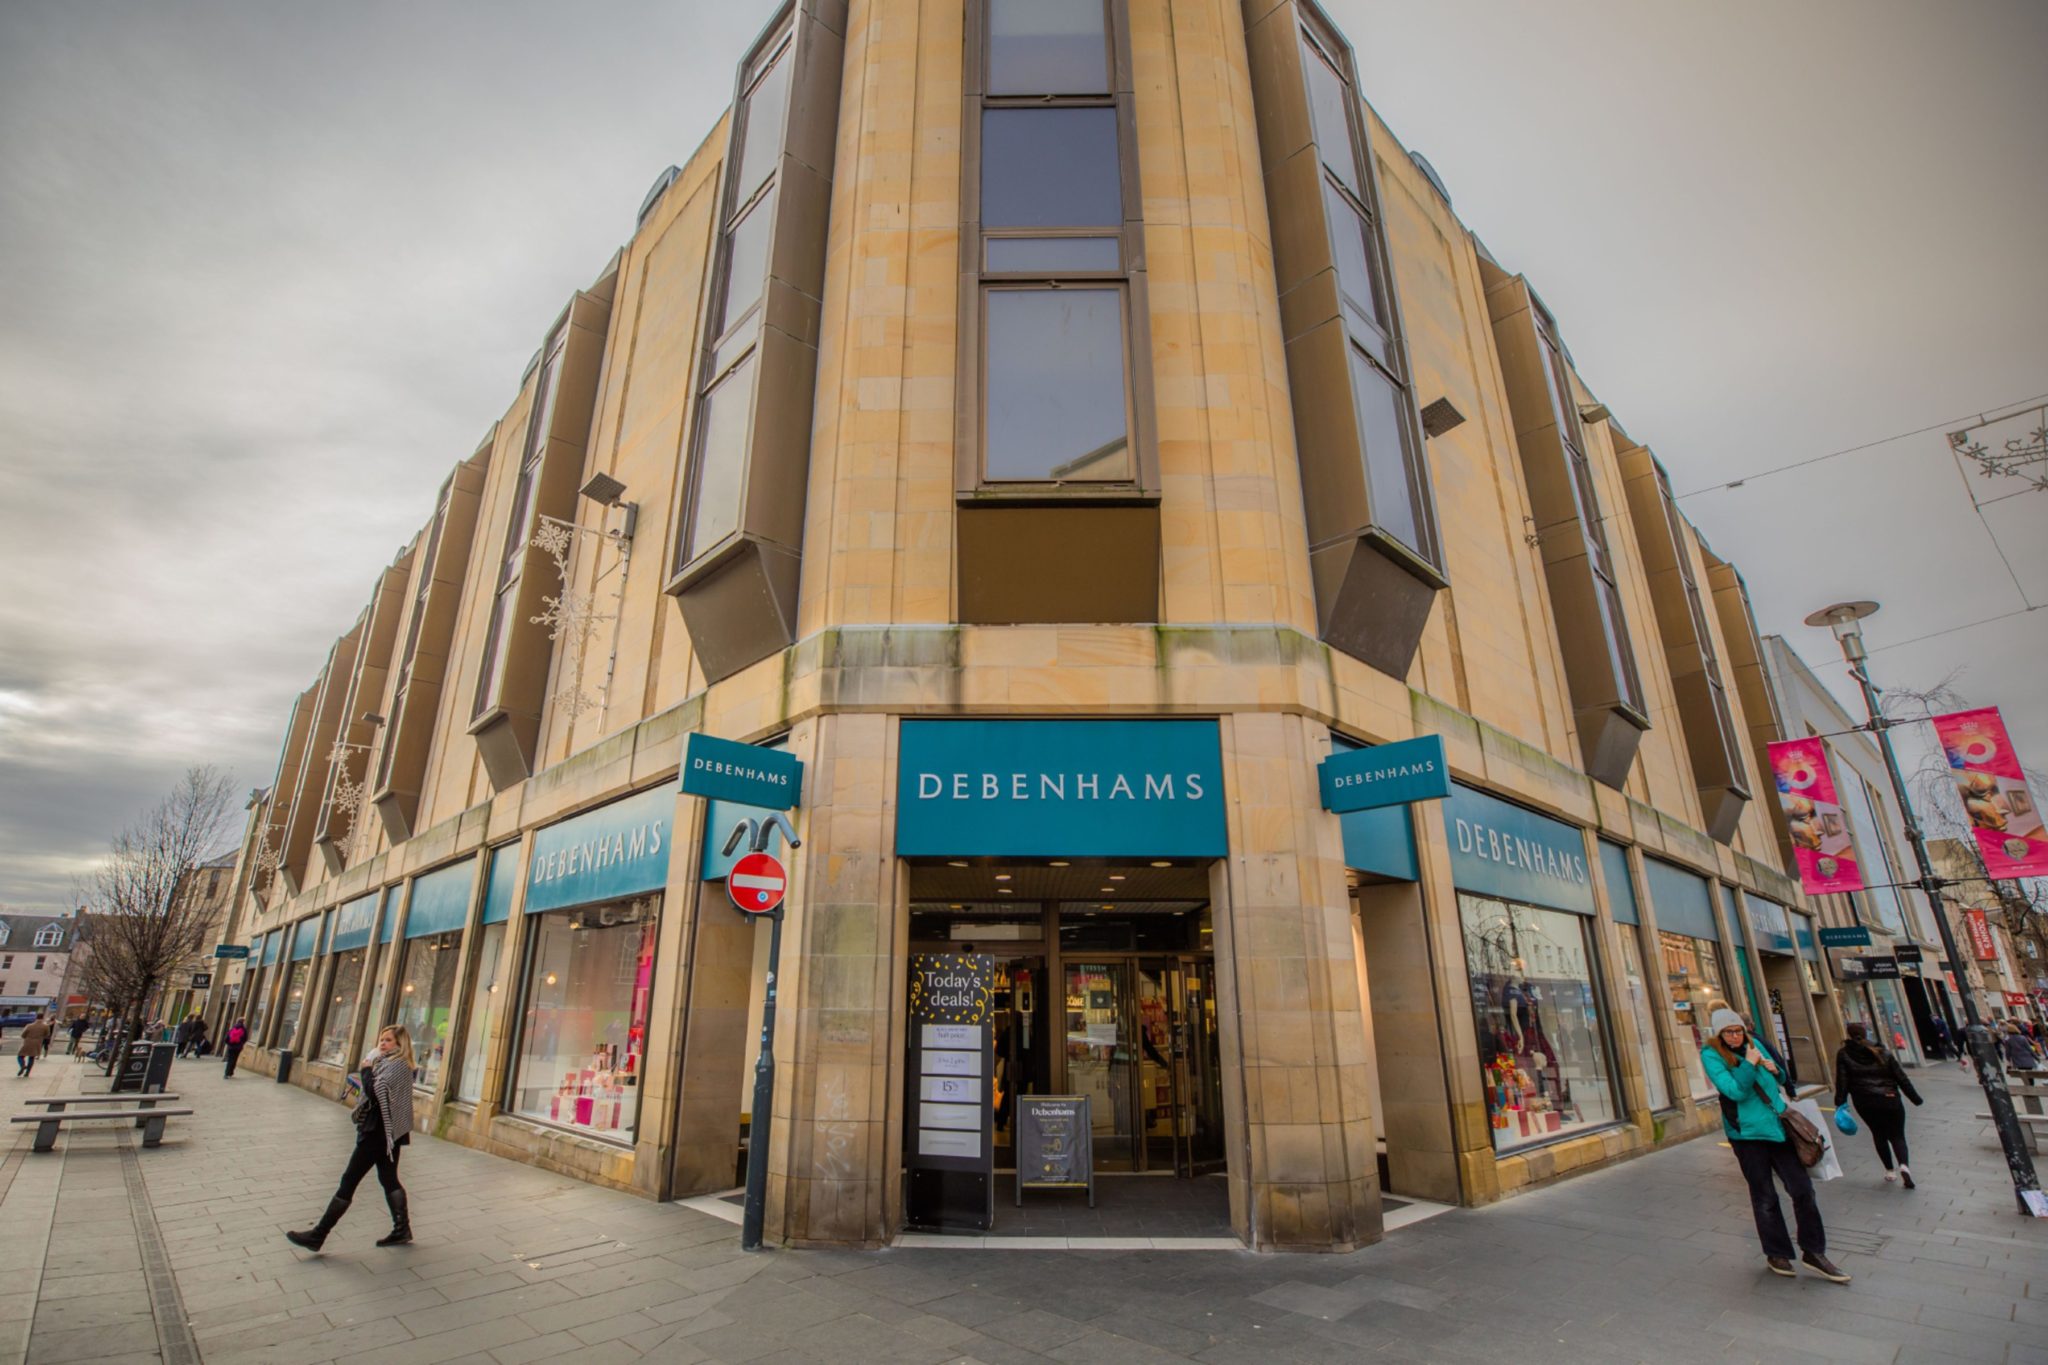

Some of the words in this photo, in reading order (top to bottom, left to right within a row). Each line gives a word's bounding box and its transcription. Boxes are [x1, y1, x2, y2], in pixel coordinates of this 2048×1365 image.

[693, 757, 789, 786] DEBENHAMS
[1334, 760, 1436, 789] DEBENHAMS
[918, 773, 1204, 800] DEBENHAMS
[533, 819, 663, 885] DEBENHAMS
[1455, 818, 1584, 884] DEBENHAMS
[924, 971, 982, 991] Today's
[930, 990, 975, 1007] deals!
